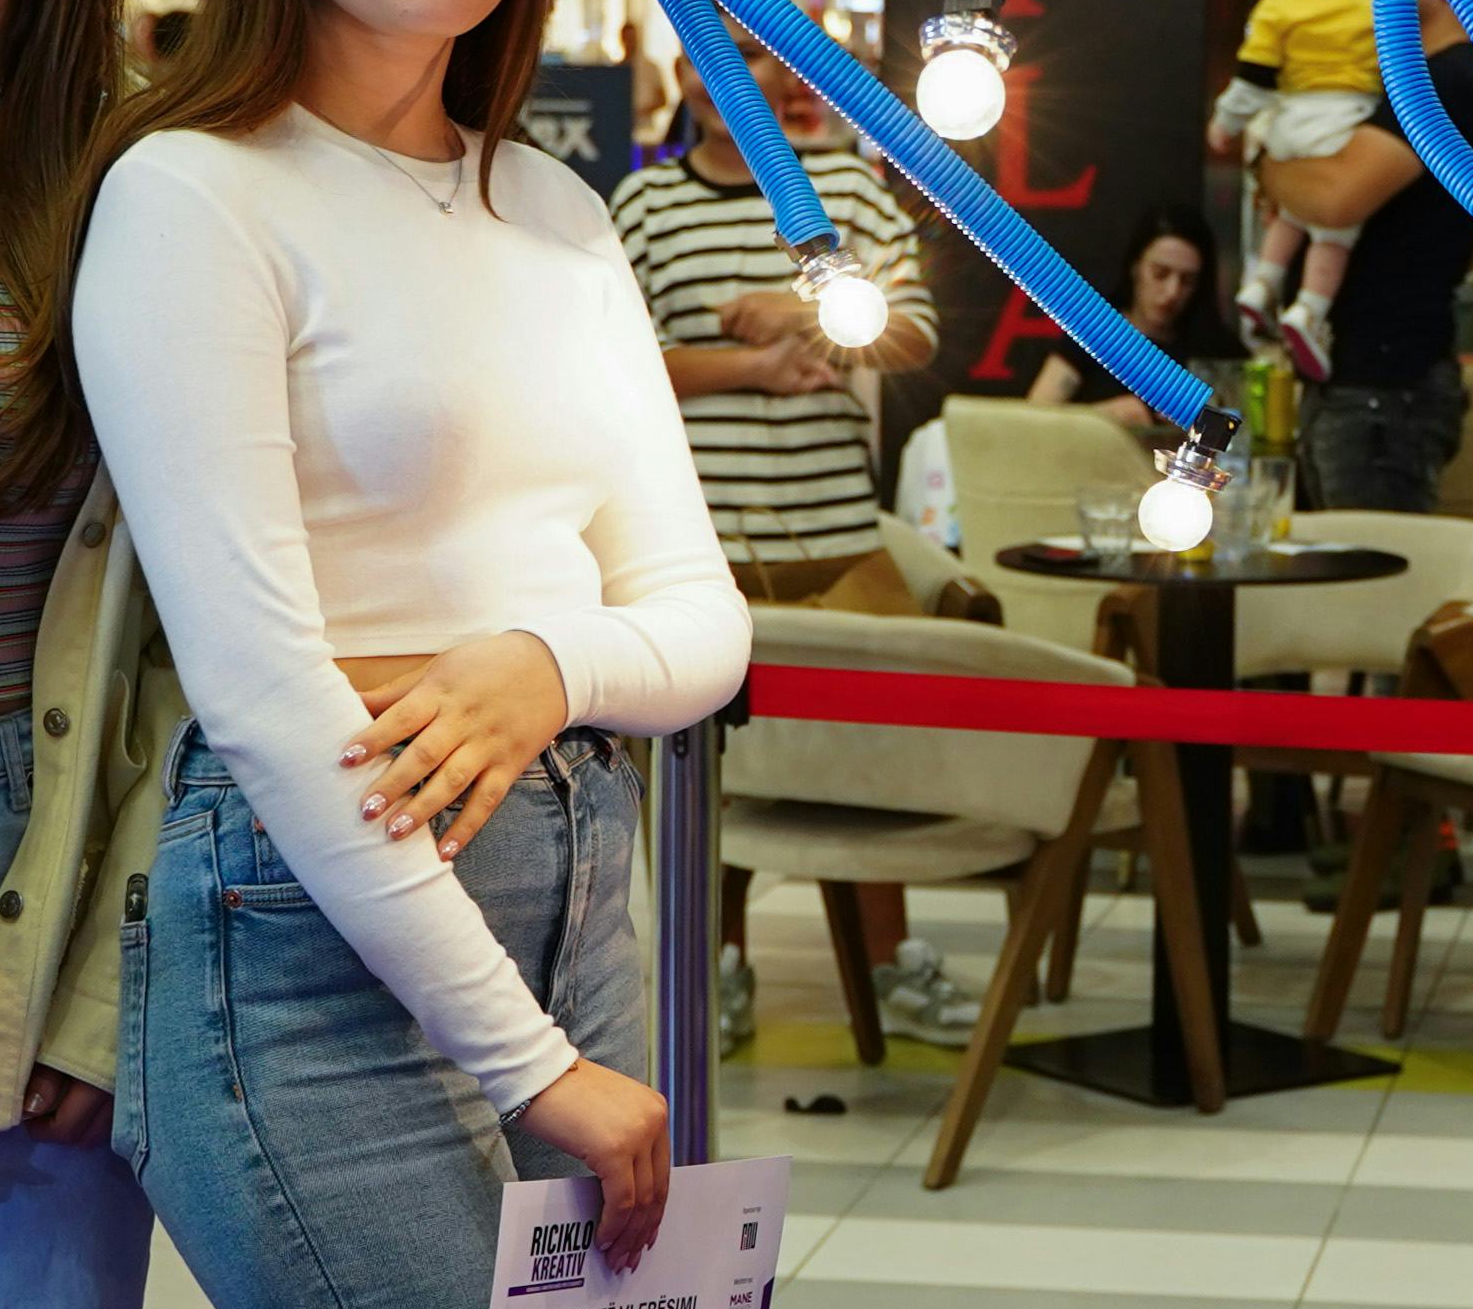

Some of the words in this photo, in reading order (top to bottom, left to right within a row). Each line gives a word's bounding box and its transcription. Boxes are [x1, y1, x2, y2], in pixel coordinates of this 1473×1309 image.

[530, 1220, 594, 1256] RICIKLO
[531, 1251, 586, 1282] KREATIV
[729, 1292, 753, 1306] MANE
